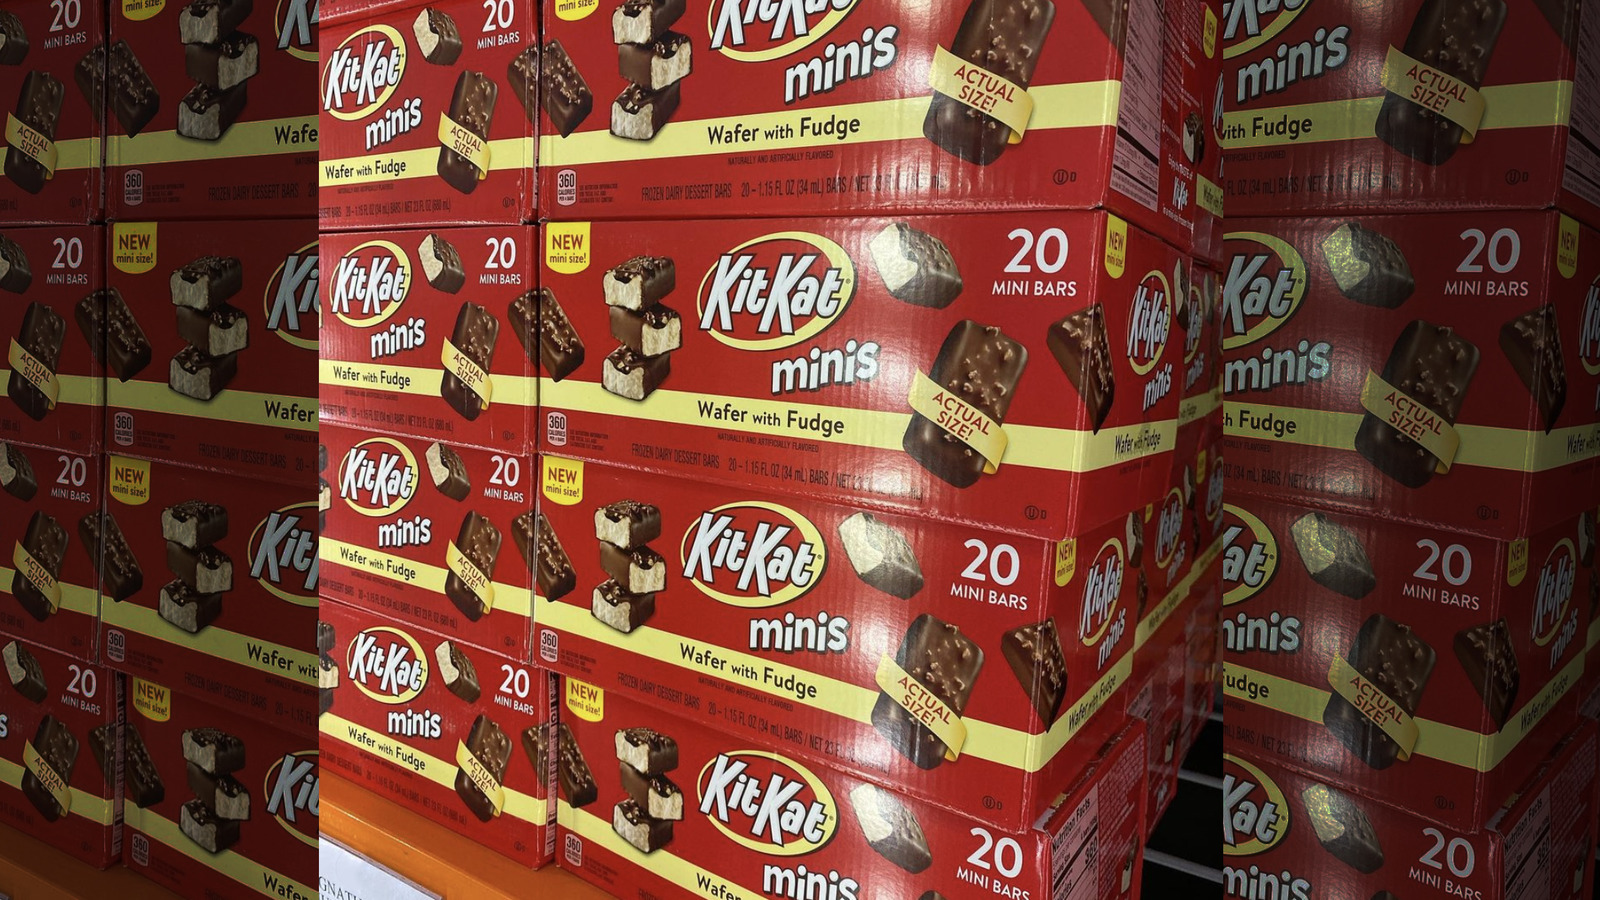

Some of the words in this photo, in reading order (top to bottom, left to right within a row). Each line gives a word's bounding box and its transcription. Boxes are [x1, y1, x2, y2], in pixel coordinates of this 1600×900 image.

[49, 0, 81, 32] 20
[482, 0, 514, 32] 20
[477, 36, 496, 49] MINI
[498, 31, 520, 45] BARS
[324, 40, 400, 110] KitKat
[784, 25, 898, 103] minis
[1236, 25, 1350, 103] minis
[953, 64, 1016, 103] ACTUAL
[958, 85, 996, 113] SIZE!
[1405, 64, 1468, 103] ACTUAL
[1410, 85, 1448, 113] SIZE!
[366, 97, 422, 150] minis
[450, 126, 481, 152] ACTUAL
[707, 125, 760, 145] Wafer
[764, 123, 793, 140] with
[800, 115, 861, 139] Fudge
[1252, 115, 1313, 139] Fudge
[453, 140, 472, 159] SIZE!
[325, 164, 354, 179] Wafer
[356, 166, 372, 177] with
[375, 159, 406, 176] Fudge
[559, 173, 574, 188] 360
[641, 186, 664, 201] FROZEN
[666, 185, 684, 200] DAIRY
[685, 184, 713, 199] DESSERT
[715, 183, 732, 198] BARS
[741, 182, 749, 197] 20
[758, 181, 774, 197] 1.15
[775, 181, 783, 196] FL
[785, 180, 795, 196] OZ
[796, 180, 808, 196] (34
[810, 179, 824, 196] mL)
[826, 178, 846, 193] BARS
[855, 175, 870, 192] NET
[51, 237, 83, 269] 20
[119, 233, 151, 250] NEW
[484, 237, 516, 269] 20
[552, 233, 584, 250] NEW
[1003, 227, 1069, 274] 20
[1109, 231, 1124, 248] NEW
[1455, 227, 1521, 274] 20
[117, 252, 135, 263] mini
[136, 252, 154, 264] size!
[550, 252, 568, 263] mini
[569, 252, 587, 264] size!
[46, 273, 65, 284] MINI
[67, 273, 88, 285] BARS
[331, 256, 405, 315] KitKat
[479, 273, 498, 284] MINI
[500, 273, 521, 285] BARS
[700, 253, 845, 335] KitKat
[992, 280, 1029, 296] MINI
[1033, 280, 1077, 297] BARS
[1444, 280, 1481, 296] MINI
[1485, 280, 1529, 297] BARS
[370, 316, 426, 359] minis
[1127, 285, 1168, 360] KitKat
[20, 353, 50, 383] ACTUAL
[23, 366, 43, 387] SIZE!
[333, 366, 360, 382] Wafer
[362, 372, 378, 383] with
[380, 370, 411, 388] Fudge
[453, 353, 483, 383] ACTUAL
[456, 366, 476, 387] SIZE!
[772, 339, 880, 395] minis
[1224, 339, 1332, 395] minis
[1143, 363, 1172, 411] minis
[116, 415, 132, 430] 360
[265, 400, 315, 423] Wafer
[549, 415, 565, 430] 360
[698, 400, 748, 423] Wafer
[752, 412, 781, 427] with
[787, 410, 845, 438] Fudge
[932, 391, 990, 436] ACTUAL
[937, 411, 973, 442] SIZE!
[1239, 410, 1297, 438] Fudge
[1384, 391, 1442, 436] ACTUAL
[1389, 411, 1425, 442] SIZE!
[56, 455, 87, 487] 20
[115, 467, 144, 485] NEW
[340, 447, 414, 508] KitKat
[489, 455, 520, 487] 20
[548, 467, 577, 485] NEW
[51, 487, 69, 500] MINI
[70, 491, 91, 503] BARS
[484, 487, 502, 500] MINI
[503, 491, 524, 503] BARS
[546, 484, 562, 496] mini
[563, 487, 580, 498] size!
[378, 515, 432, 547] minis
[340, 546, 367, 566] Wafer
[369, 558, 384, 571] with
[386, 559, 416, 581] Fudge
[683, 512, 815, 597] KitKat
[960, 538, 1020, 585] 20
[1059, 543, 1074, 562] NEW
[1412, 538, 1472, 585] 20
[457, 556, 486, 589] ACTUAL
[460, 570, 479, 590] SIZE!
[950, 582, 984, 602] MINI
[989, 591, 1028, 611] BARS
[1080, 555, 1122, 639] KitKat
[1402, 582, 1436, 602] MINI
[1441, 591, 1480, 611] BARS
[542, 632, 557, 647] 360
[749, 610, 850, 653] minis
[1098, 608, 1126, 671] minis
[349, 632, 424, 697] KitKat
[680, 642, 727, 672] Wafer
[731, 663, 758, 680] with
[763, 667, 817, 699] Fudge
[67, 664, 97, 698] 20
[137, 682, 165, 703] NEW
[500, 664, 530, 698] 20
[570, 682, 598, 703] NEW
[494, 694, 513, 710] MINI
[514, 701, 534, 716] BARS
[569, 698, 584, 709] mini
[585, 703, 600, 716] size!
[897, 676, 950, 725] ACTUAL
[902, 694, 936, 727] SIZE!
[387, 709, 442, 739] minis
[348, 726, 376, 749] Wafer
[378, 740, 394, 757] with
[395, 747, 426, 772] Fudge
[467, 757, 497, 792] ACTUAL
[469, 770, 489, 793] SIZE!
[700, 753, 826, 847] KitKat
[567, 836, 580, 852] 360
[966, 827, 1023, 878] 20
[1418, 827, 1475, 878] 20
[696, 873, 743, 900] Wafer
[763, 863, 859, 900] minis
[956, 866, 989, 889] MINI
[993, 879, 1031, 900] BARS
